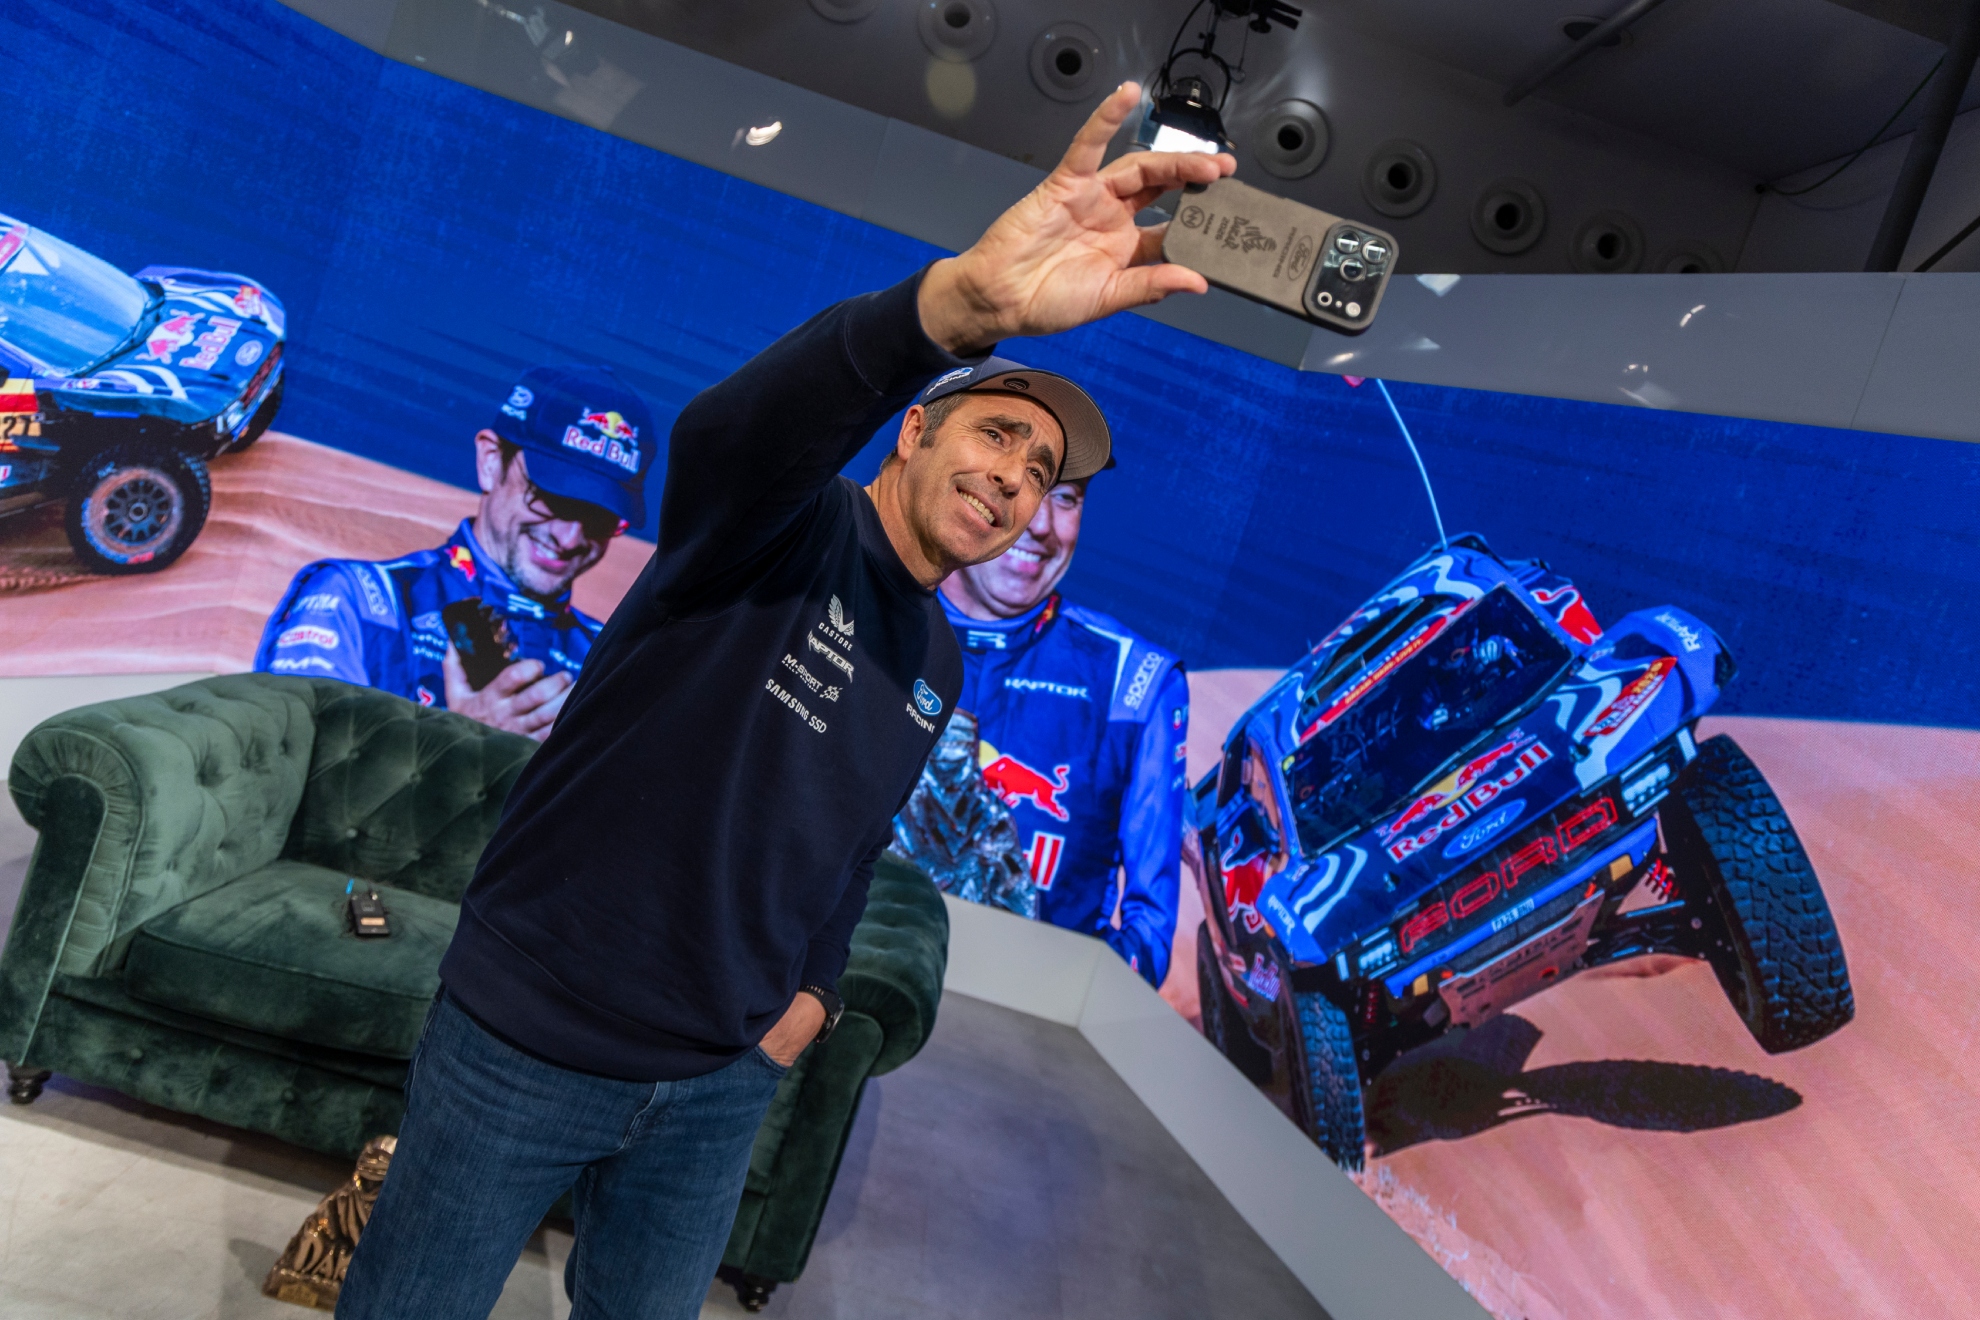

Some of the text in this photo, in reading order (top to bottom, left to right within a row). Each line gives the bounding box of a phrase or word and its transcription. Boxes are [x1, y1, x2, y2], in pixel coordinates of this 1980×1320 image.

[562, 425, 641, 473] Red Bull
[807, 629, 854, 683] RAPTOR
[818, 622, 853, 651] CASTORE
[765, 679, 827, 734] SAMSUNG SSD
[916, 684, 935, 711] Ford
[1005, 677, 1091, 702] RAPTOR
[1386, 741, 1554, 864] Red Bull
[1400, 797, 1619, 953] FORD
[293, 1231, 352, 1282] DAK
